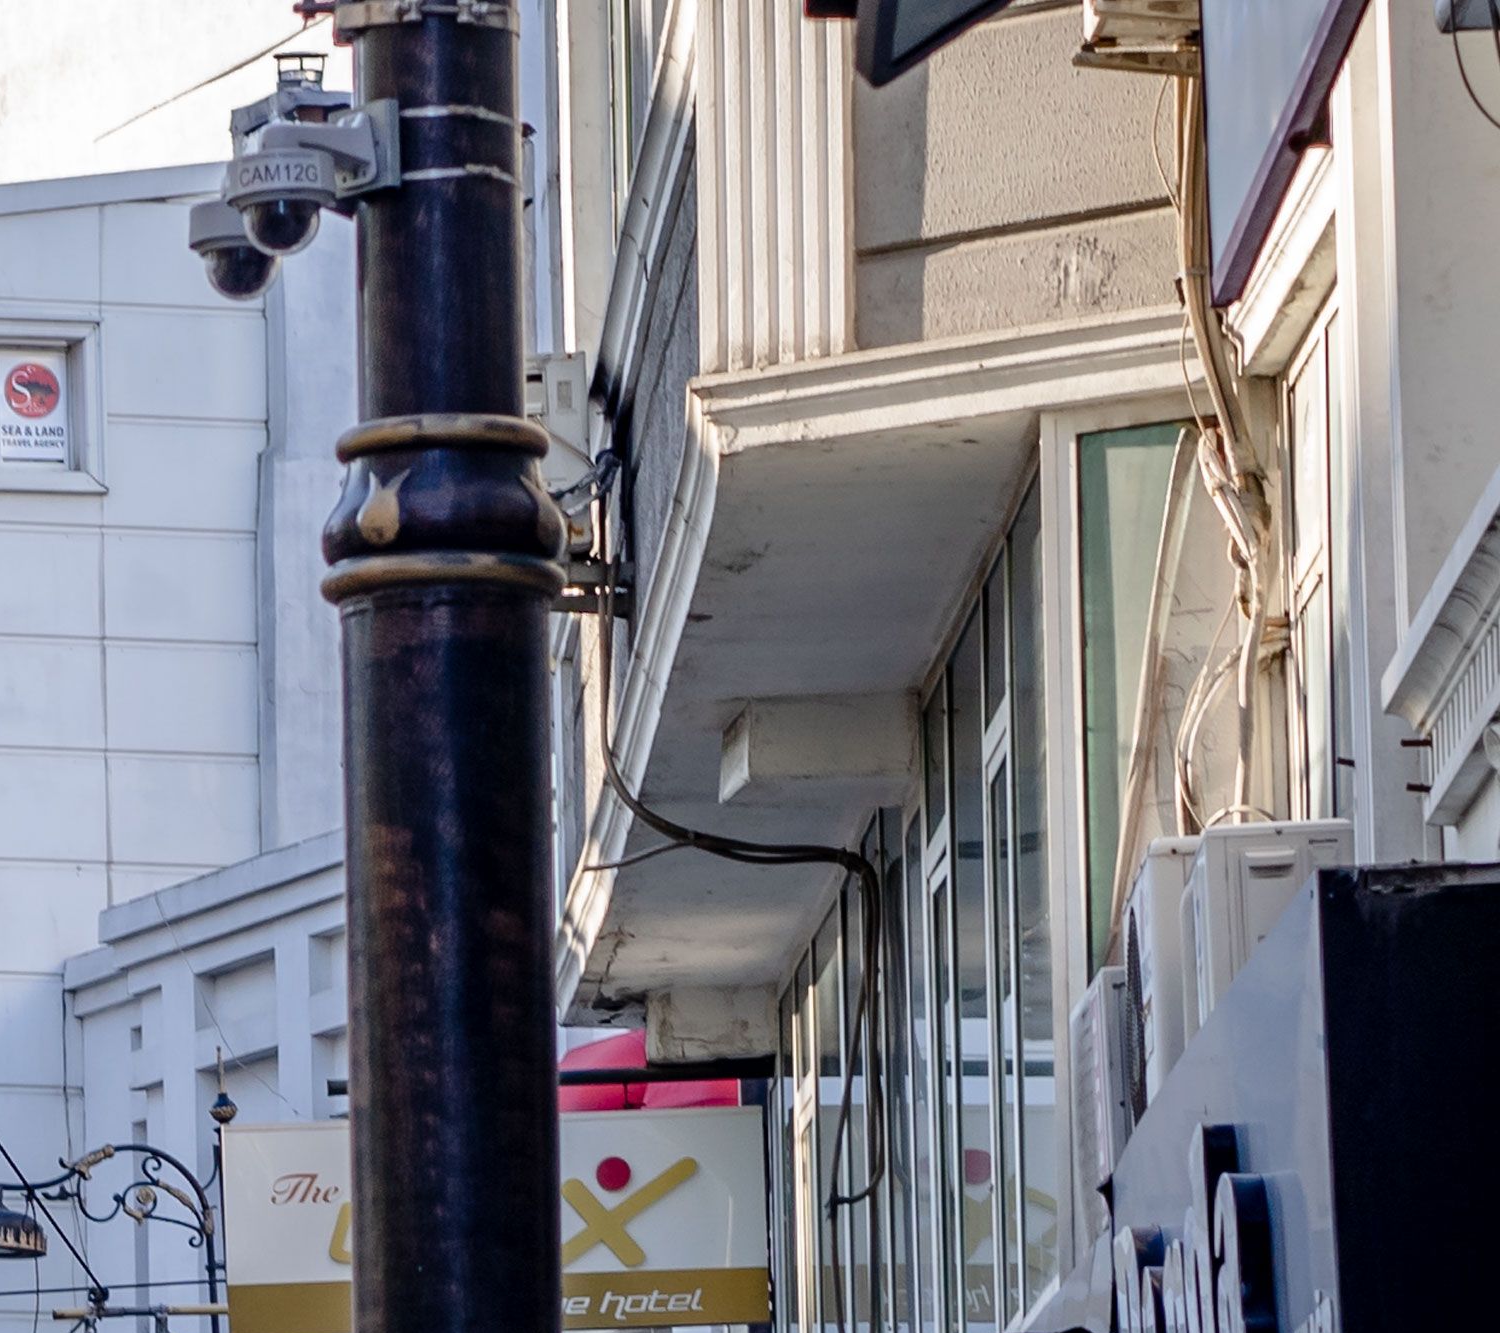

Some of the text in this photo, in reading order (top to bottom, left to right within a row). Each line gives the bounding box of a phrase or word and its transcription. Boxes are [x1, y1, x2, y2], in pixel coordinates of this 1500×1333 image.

[2, 425, 23, 436] SEA
[35, 425, 64, 437] LAND
[270, 1173, 341, 1206] The
[601, 1288, 705, 1321] hotel
